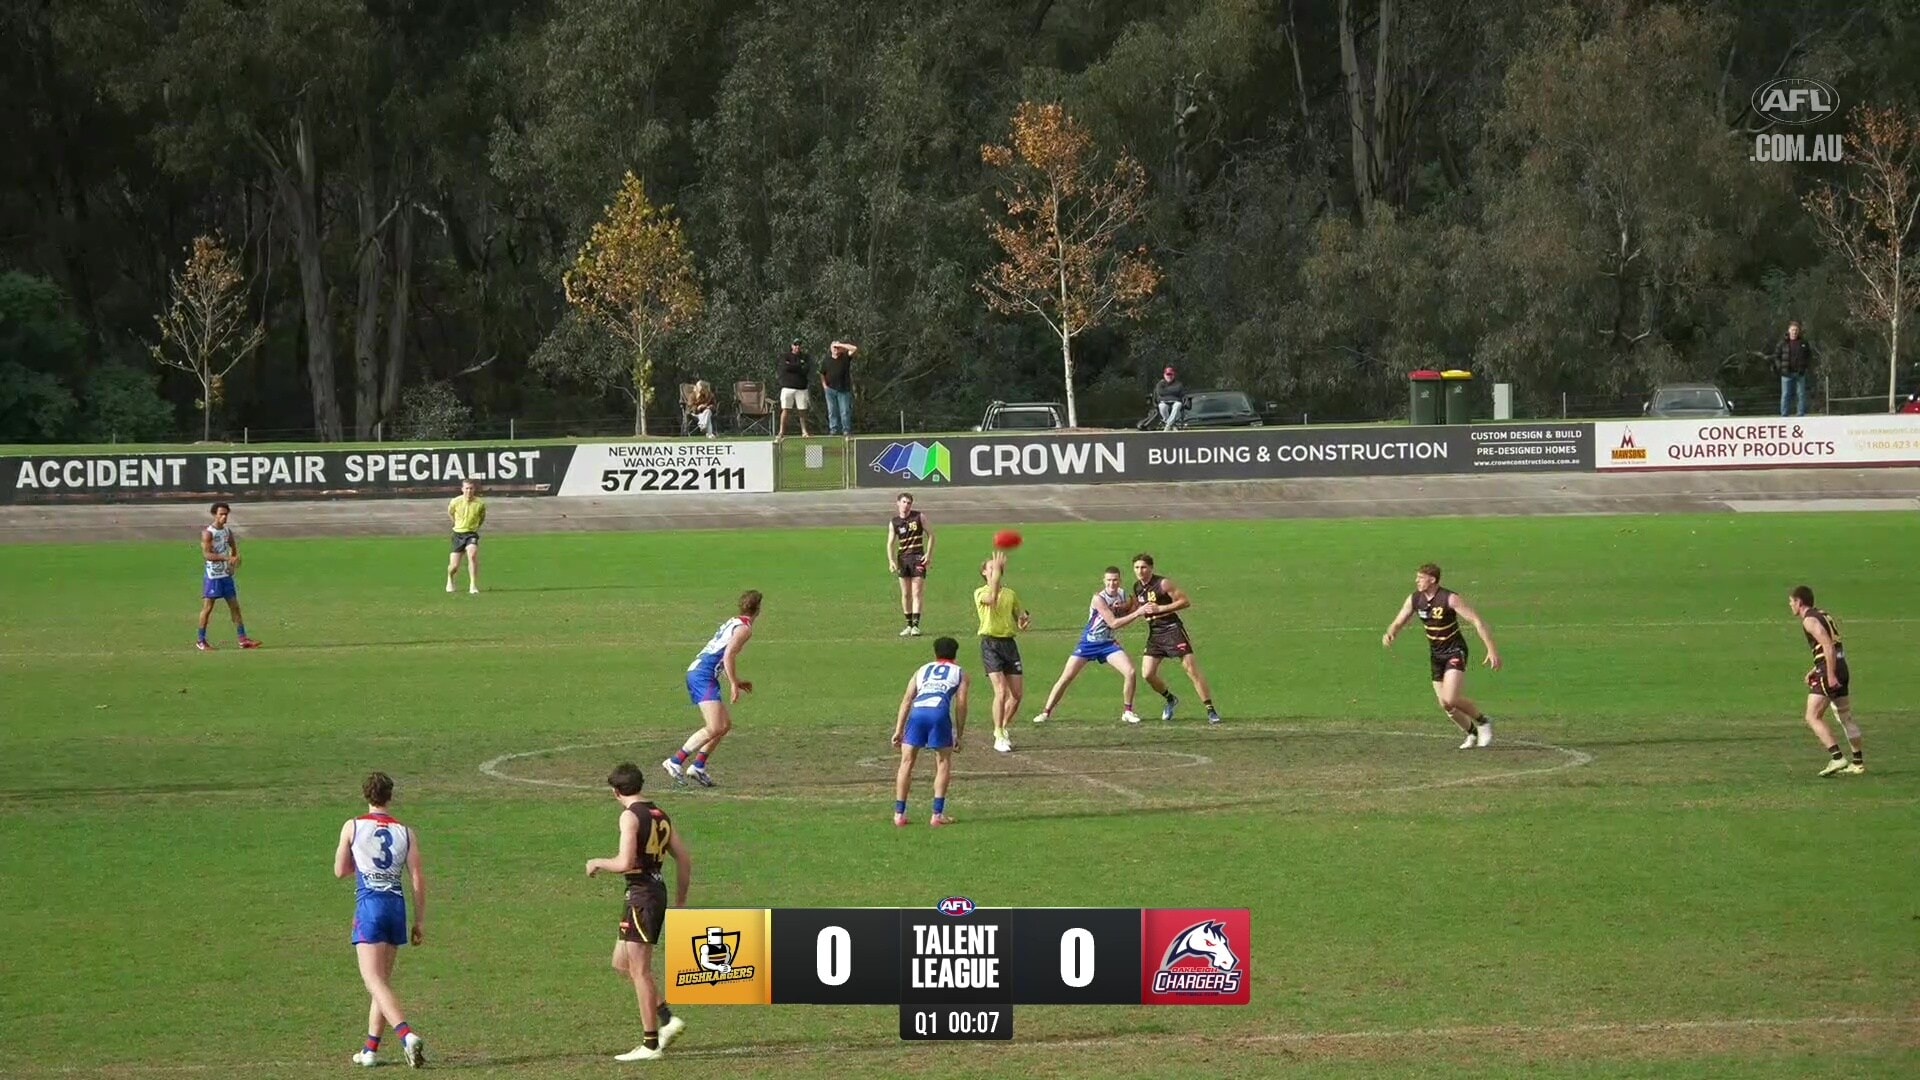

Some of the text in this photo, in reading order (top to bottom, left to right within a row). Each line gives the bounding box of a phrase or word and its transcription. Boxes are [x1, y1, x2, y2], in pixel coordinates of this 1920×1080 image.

[1471, 430, 1582, 440] CUSTOM DESIGN & BUILD
[1698, 425, 1804, 441] CONCRETE &
[608, 445, 675, 457] NEWMAN
[1476, 446, 1577, 455] PRE-DESIGNED HOMES
[1611, 449, 1646, 460] MAWSONS
[1667, 441, 1835, 460] QUARRY PRODUCTS
[622, 457, 722, 468] WANGARATTA
[969, 442, 1449, 477] CROWN BUILDING & CONSTRUCTION
[1473, 458, 1580, 466] www.crownconstructions.com.au
[15, 450, 541, 489] ACCIDENT REPAIR SPECIALIST
[1431, 606, 1444, 619] 32
[922, 664, 951, 682] 19
[645, 818, 671, 863] 42
[372, 828, 394, 870] 3
